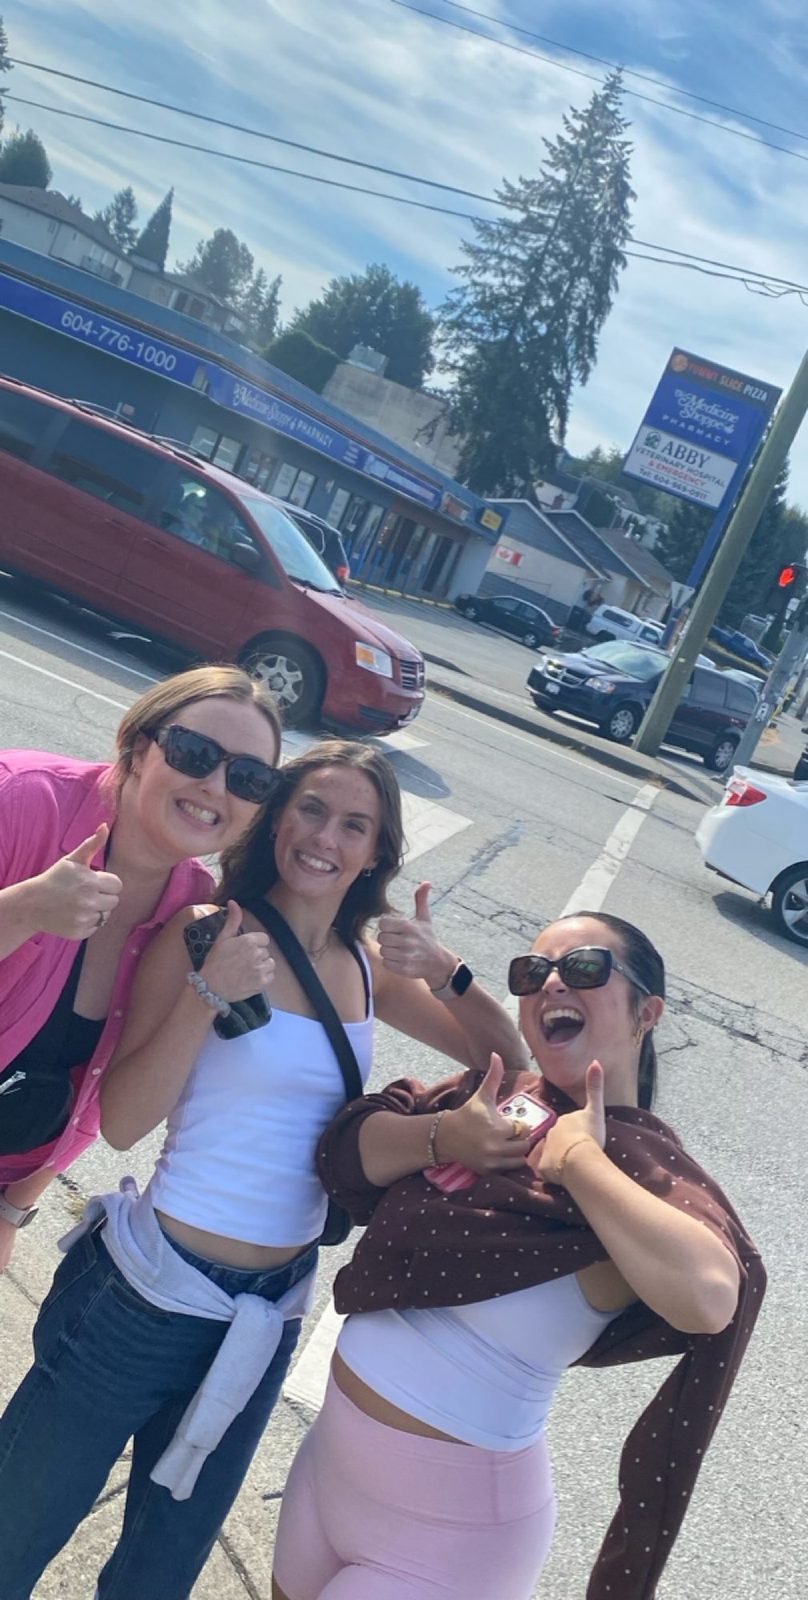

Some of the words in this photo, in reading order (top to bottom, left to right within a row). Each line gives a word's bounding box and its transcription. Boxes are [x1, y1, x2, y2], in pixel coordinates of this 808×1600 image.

[61, 311, 177, 371] 604-776-1000
[720, 375, 744, 392] SLICE
[743, 384, 768, 402] PIZZA
[678, 393, 739, 423] Medicine
[679, 406, 725, 431] Shoppe
[296, 420, 334, 448] PHARMACY
[662, 414, 731, 446] PHARMACY
[635, 446, 686, 470] VETERINARY
[686, 466, 725, 487] HOSPITAL
[661, 440, 711, 468] ABBY
[655, 463, 708, 487] EMERGENCY
